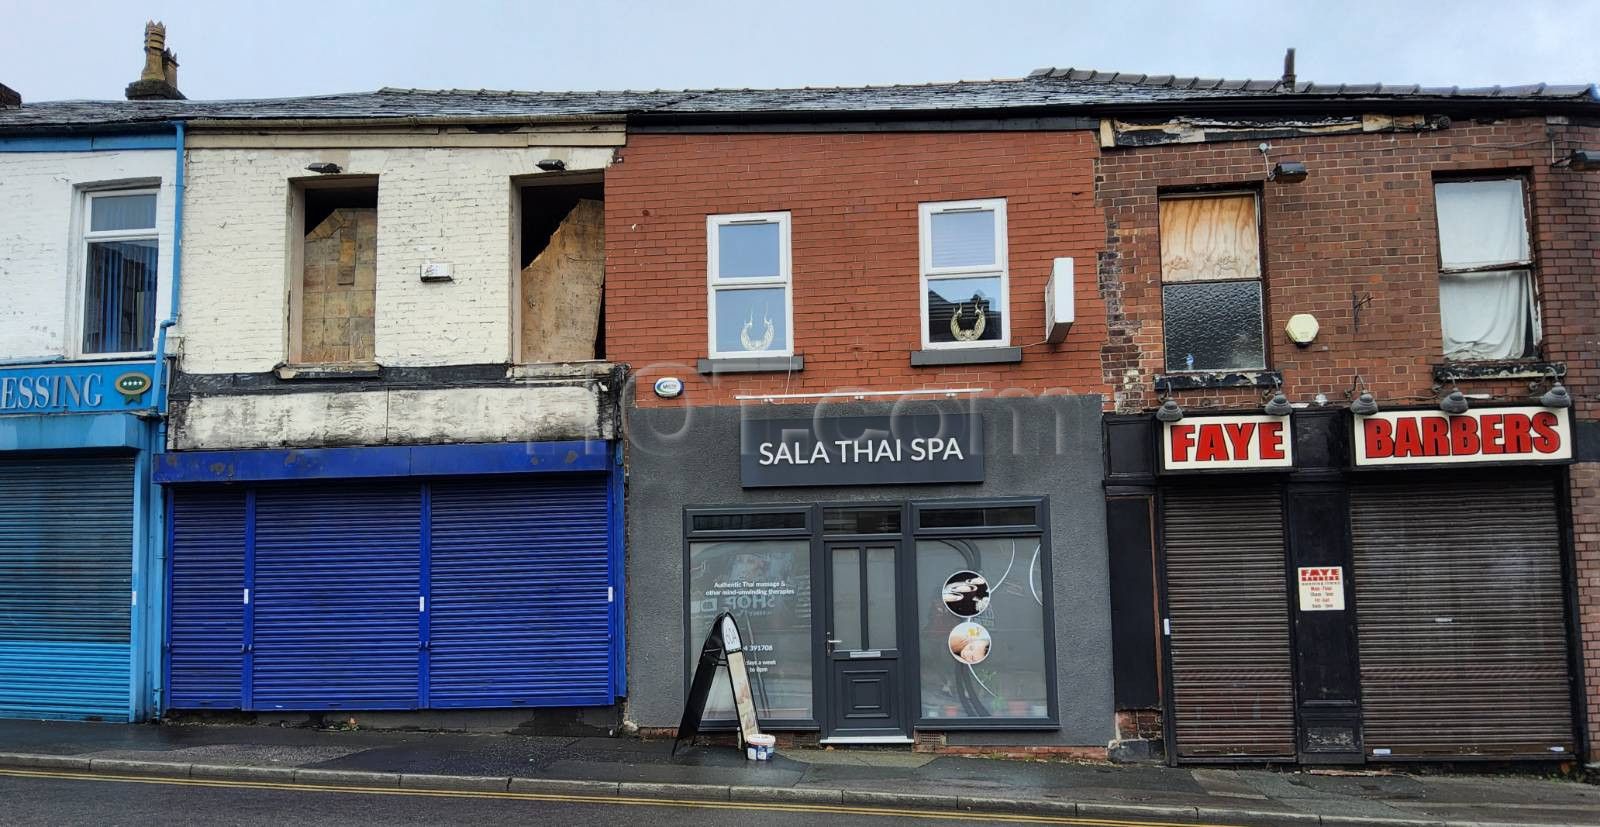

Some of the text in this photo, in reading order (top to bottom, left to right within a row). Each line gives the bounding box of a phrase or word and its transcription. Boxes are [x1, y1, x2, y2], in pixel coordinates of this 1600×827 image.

[1, 373, 103, 409] ESSING
[759, 438, 964, 465] SALA THAI SPA
[1170, 421, 1285, 462] FAYE
[1365, 411, 1561, 458] BARBERS
[768, 588, 795, 596] therapies
